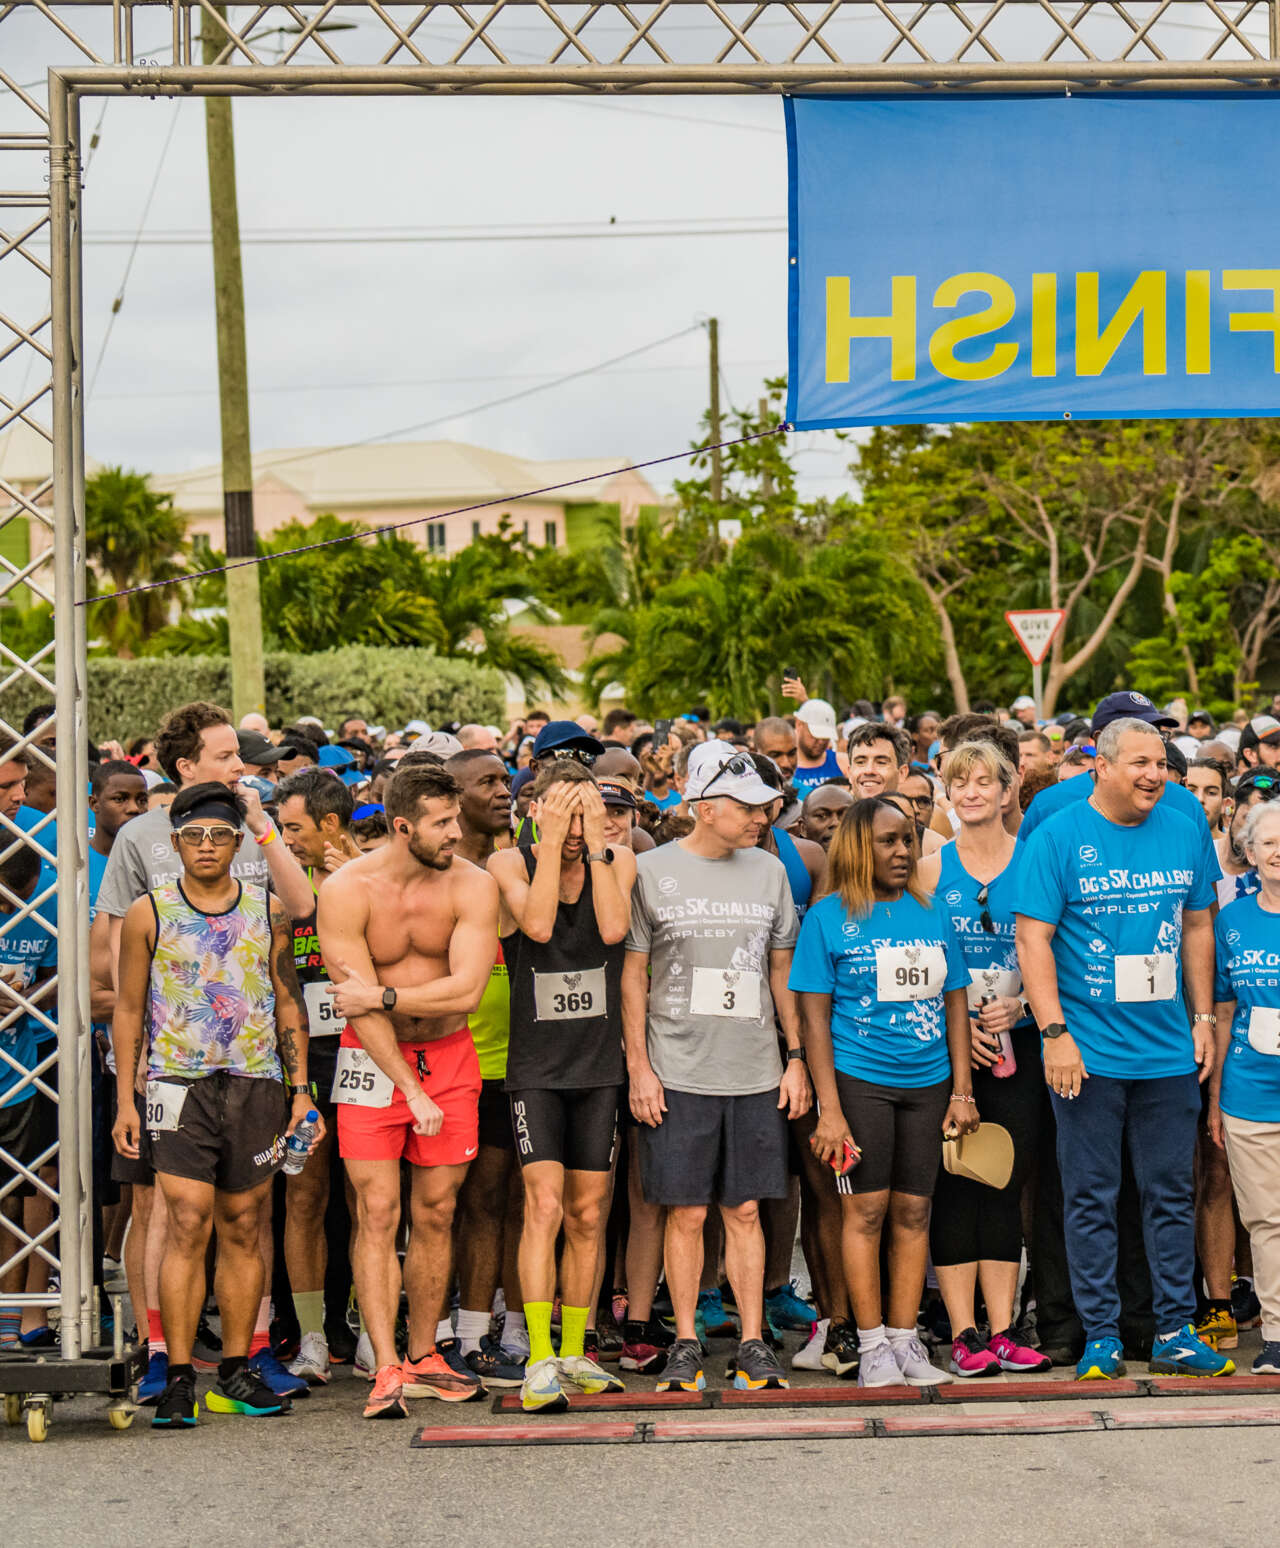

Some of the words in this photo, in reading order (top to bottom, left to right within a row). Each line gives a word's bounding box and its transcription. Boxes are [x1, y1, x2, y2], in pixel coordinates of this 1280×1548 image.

[230, 860, 268, 877] LLENGE
[1109, 869, 1132, 889] 5K
[685, 898, 710, 916] 5K
[1082, 902, 1160, 915] APPLEBY
[952, 916, 971, 933] 5K
[663, 929, 737, 941] APPLEBY
[0, 937, 49, 954] ALLENGE
[294, 956, 308, 966] THE
[1242, 949, 1266, 966] 5K
[895, 967, 929, 986] 961
[1147, 975, 1155, 994] 1
[553, 991, 594, 1013] 369
[722, 991, 736, 1010] 3
[339, 1068, 376, 1092] 255
[147, 1103, 164, 1123] 30
[514, 1100, 534, 1155] SKINS
